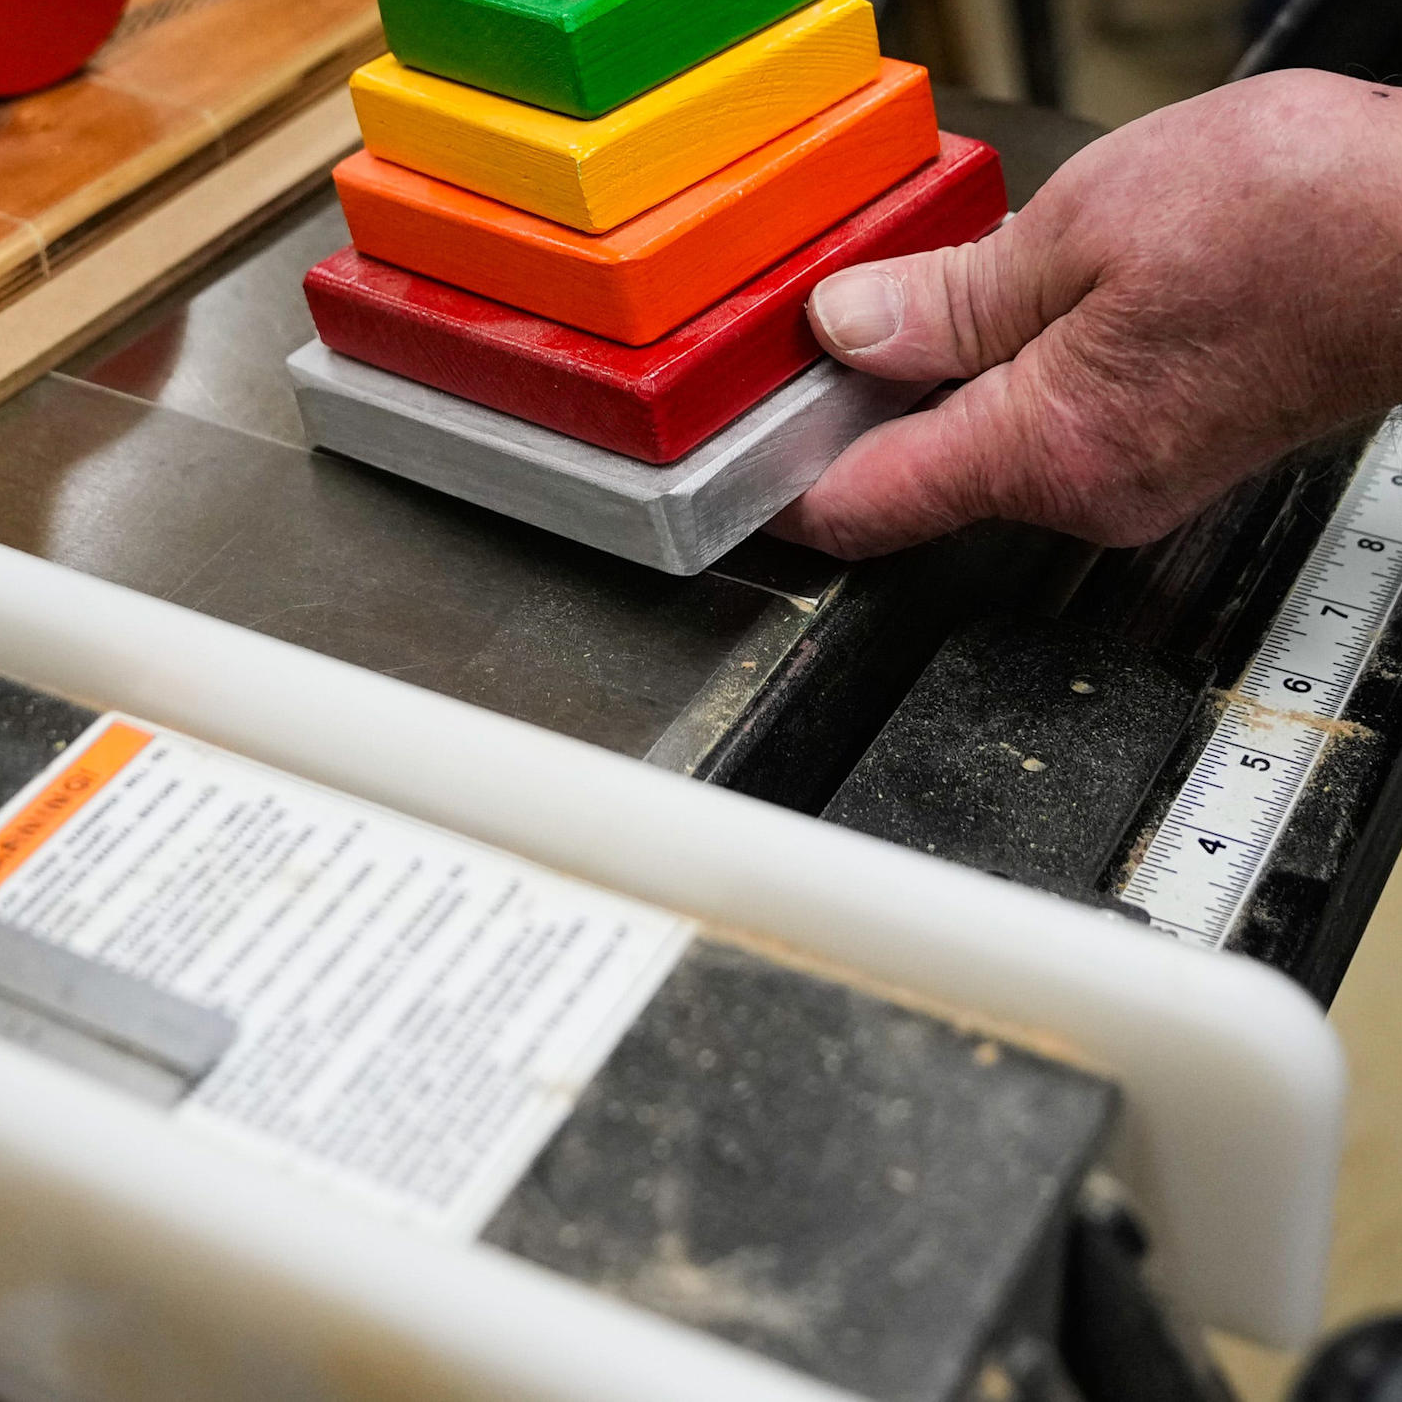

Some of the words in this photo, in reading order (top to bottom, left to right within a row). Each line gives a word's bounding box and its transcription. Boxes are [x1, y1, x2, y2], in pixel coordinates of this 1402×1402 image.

[1197, 836, 1227, 855] 4
[1239, 753, 1271, 772] 5
[1282, 676, 1312, 694] 6
[1320, 604, 1348, 619] 7
[1357, 538, 1385, 552] 8
